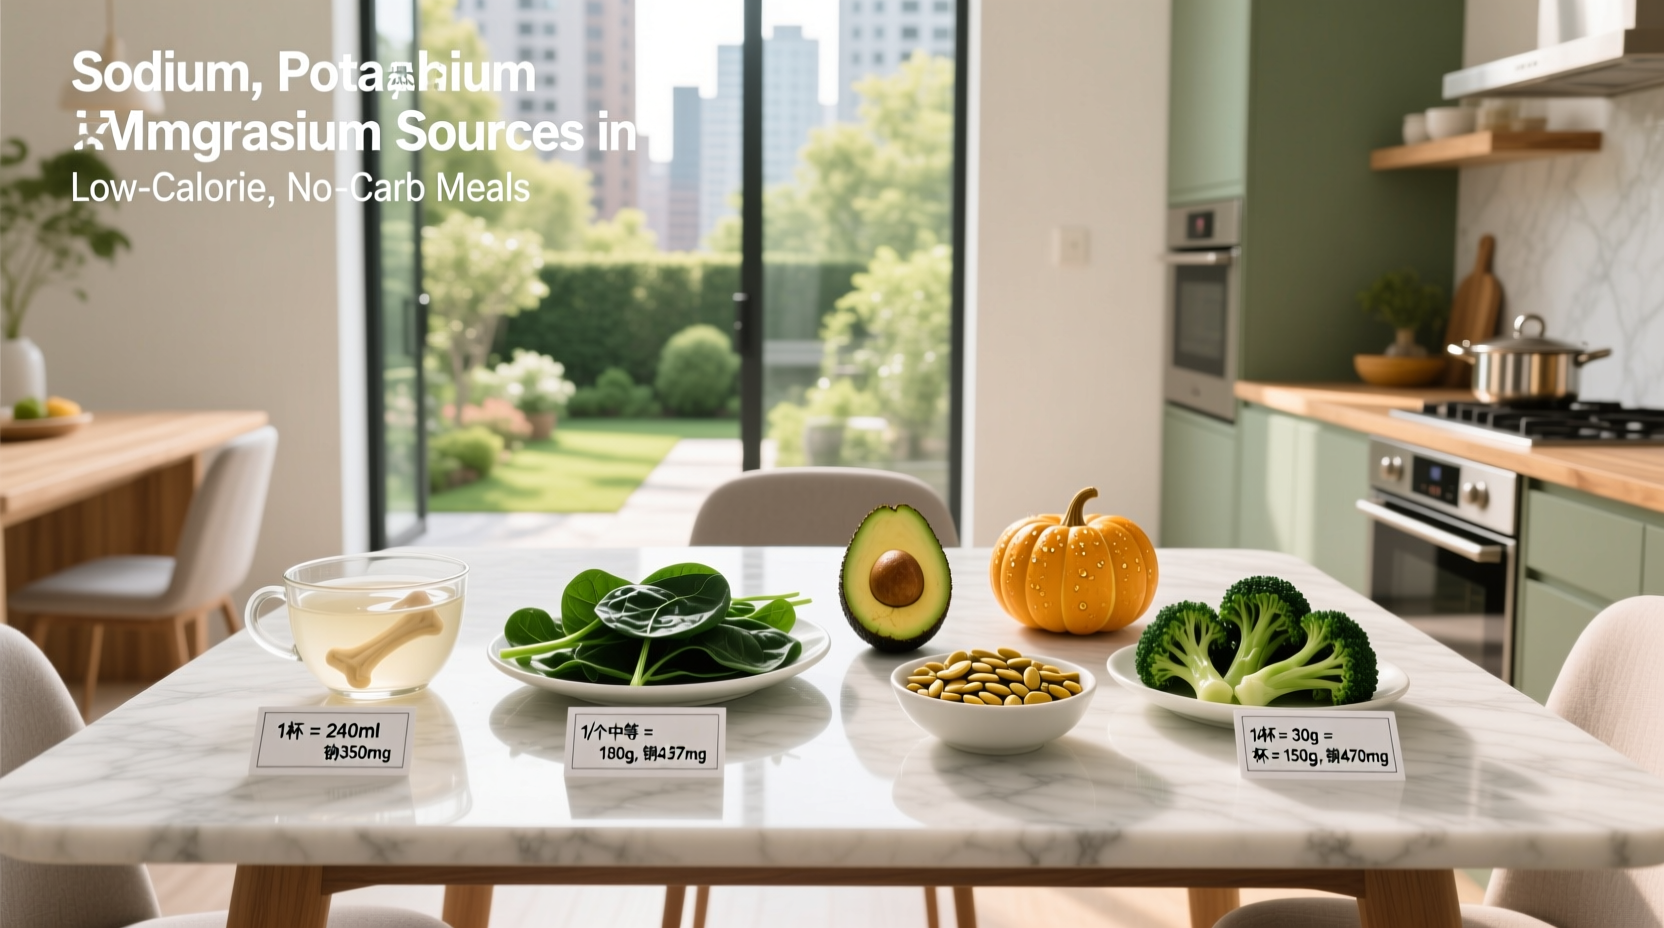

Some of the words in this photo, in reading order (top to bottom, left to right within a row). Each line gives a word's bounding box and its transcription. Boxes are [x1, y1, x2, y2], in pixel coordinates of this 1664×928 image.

[310, 727, 321, 736] =
[326, 722, 380, 739] 240ml
[644, 728, 653, 736] =
[1292, 728, 1319, 745] 30g
[599, 746, 638, 764] 180g,
[1284, 748, 1323, 767] 150g,
